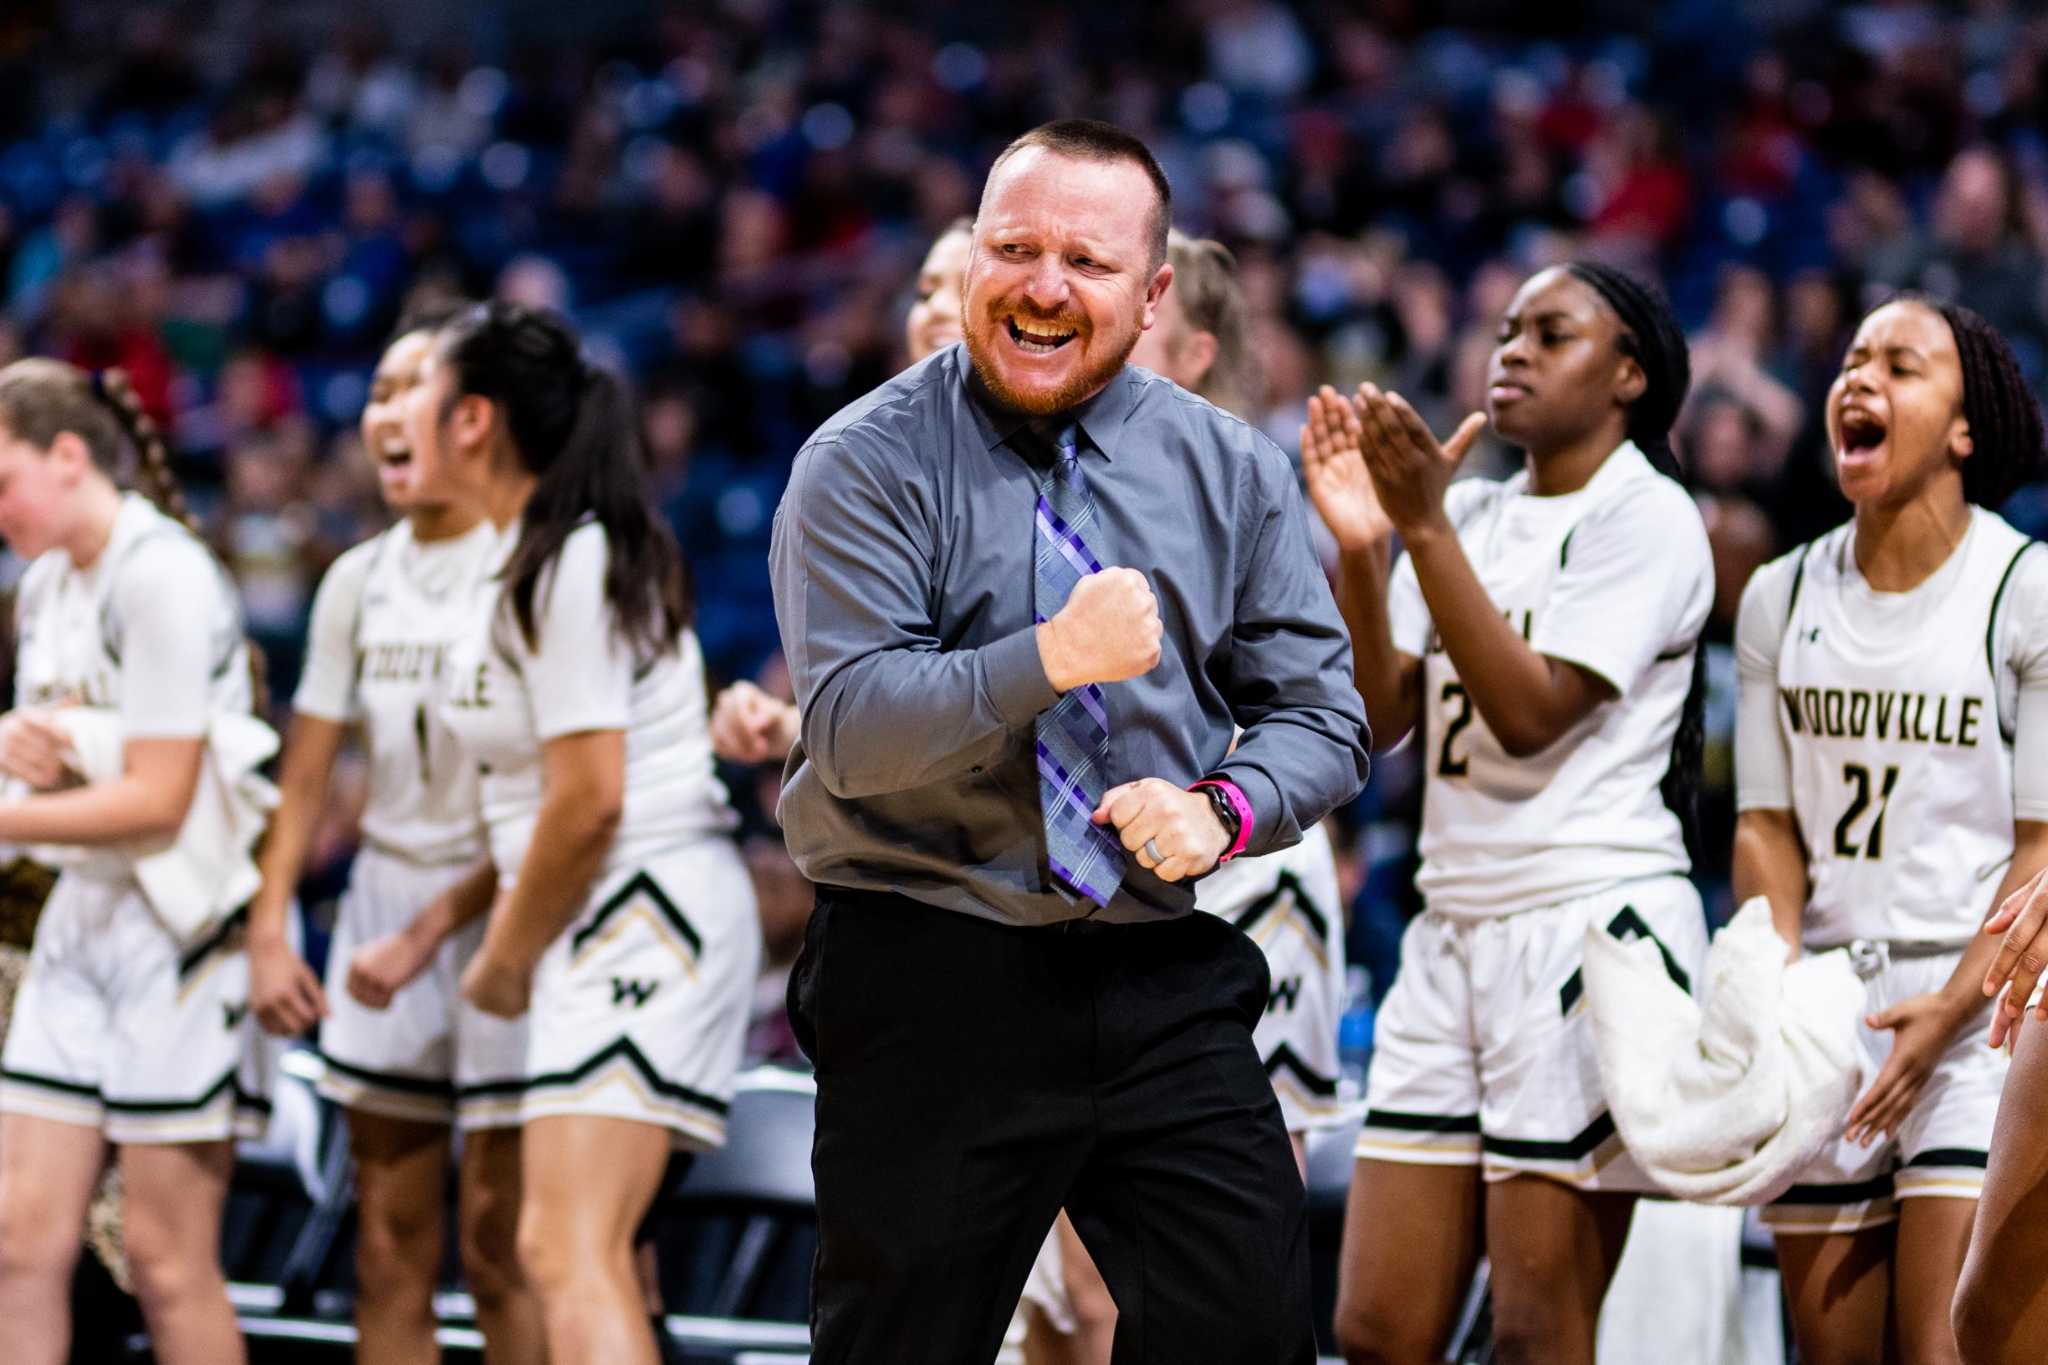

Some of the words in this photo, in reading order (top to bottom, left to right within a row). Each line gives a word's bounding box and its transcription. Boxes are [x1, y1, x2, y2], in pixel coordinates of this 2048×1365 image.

[1779, 686, 1983, 747] WOODVILLE
[1833, 762, 1900, 860] 21
[611, 976, 659, 1008] W
